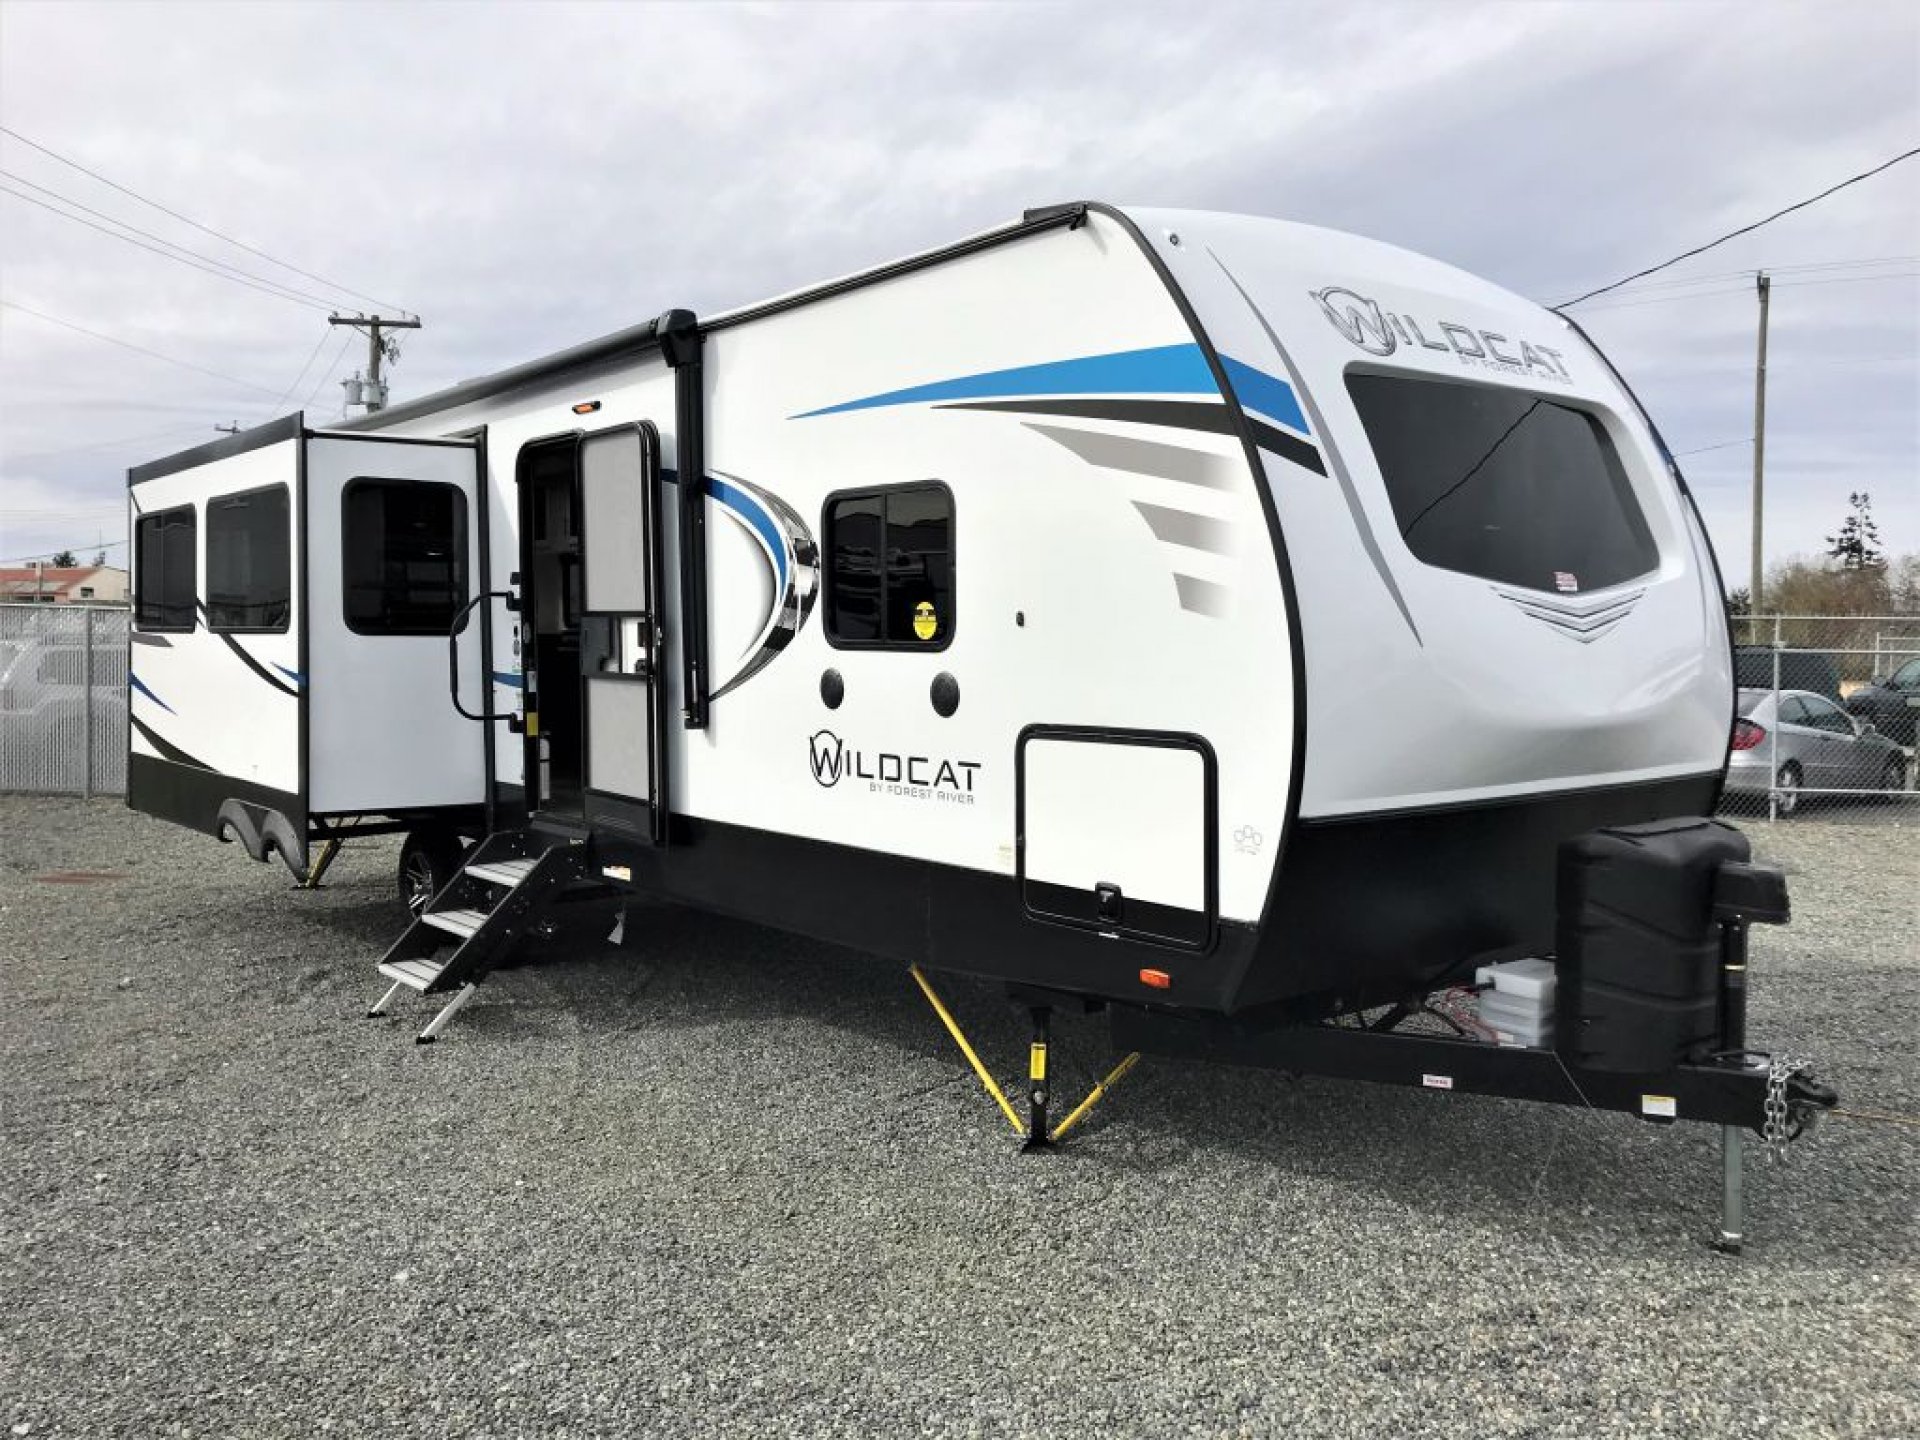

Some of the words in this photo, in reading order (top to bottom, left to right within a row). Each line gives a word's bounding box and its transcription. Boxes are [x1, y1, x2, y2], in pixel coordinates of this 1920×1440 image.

[1308, 286, 1571, 384] WILDCAT
[809, 729, 982, 791] WILDCAT
[869, 782, 884, 793] BY
[886, 785, 933, 800] FOREST
[936, 791, 975, 805] RIVER
